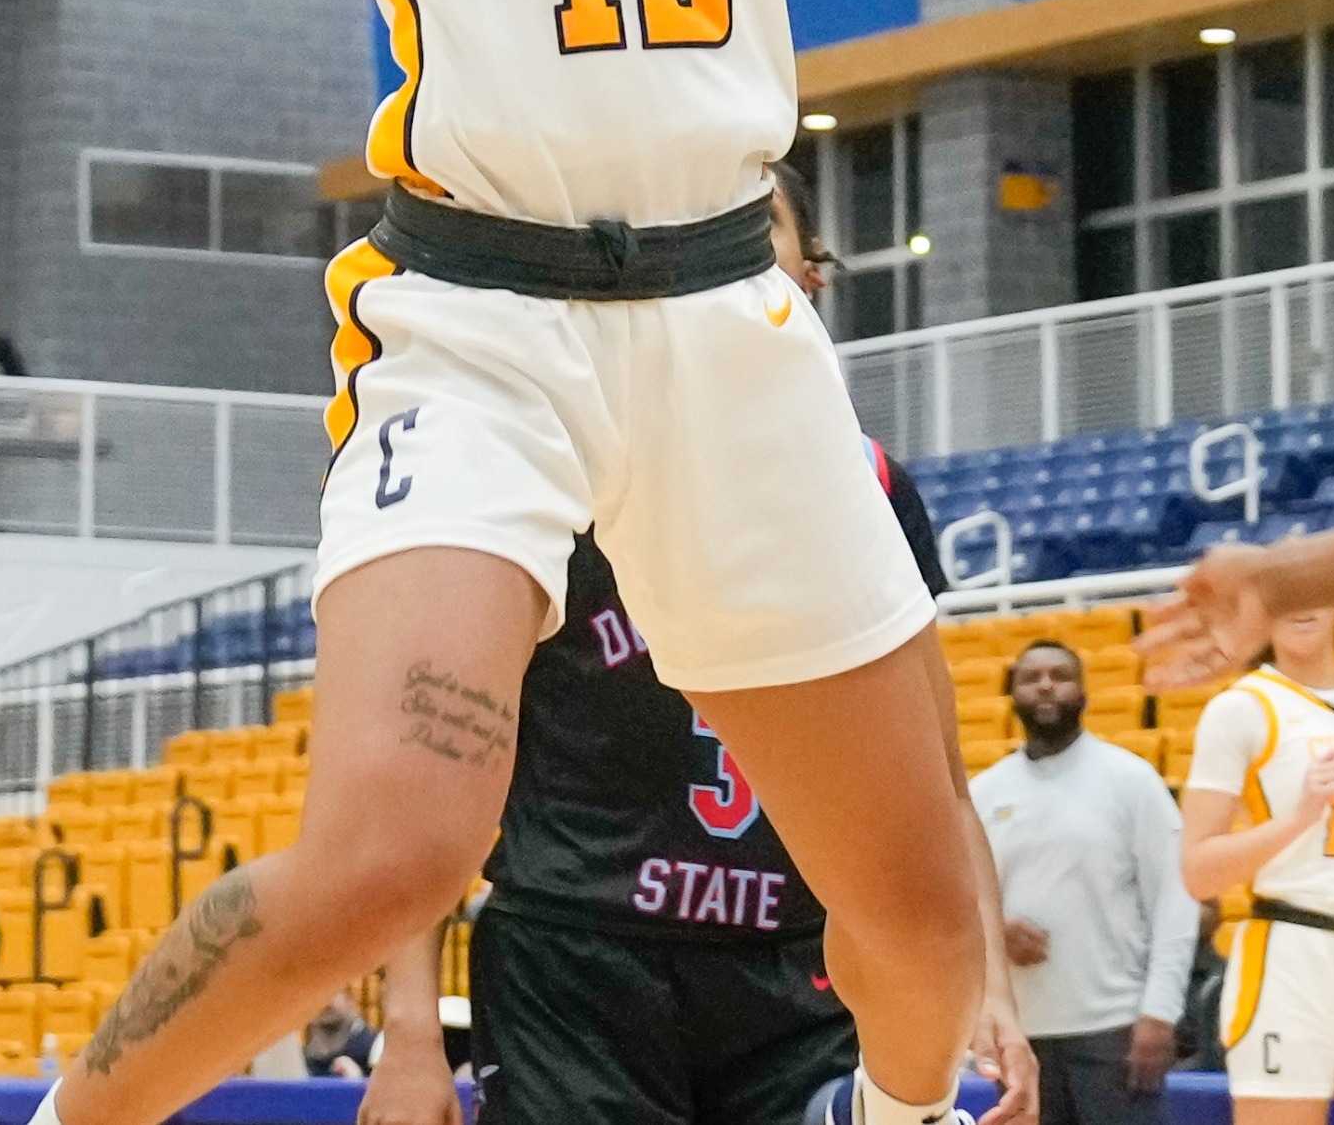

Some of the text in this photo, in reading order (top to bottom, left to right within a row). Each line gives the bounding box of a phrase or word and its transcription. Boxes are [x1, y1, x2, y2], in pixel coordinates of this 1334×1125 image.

[375, 407, 420, 509] C
[633, 857, 786, 931] STATE
[1263, 1032, 1281, 1074] C
